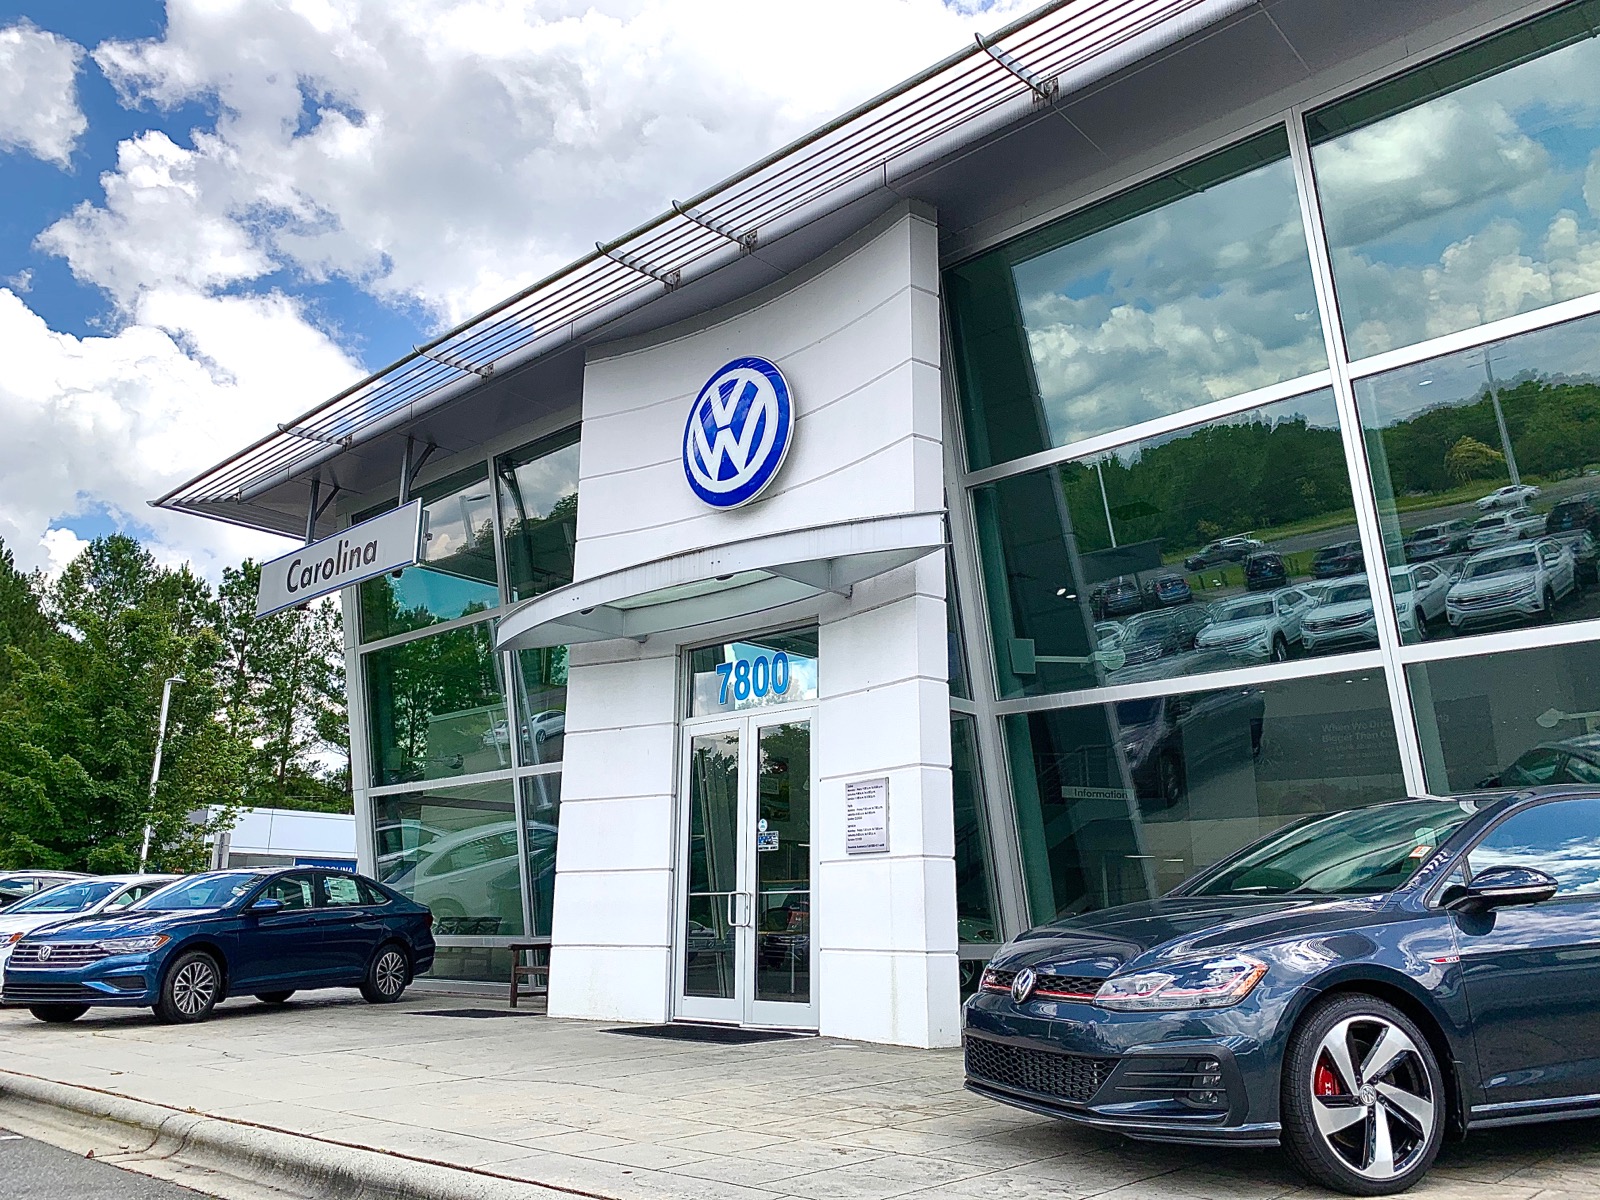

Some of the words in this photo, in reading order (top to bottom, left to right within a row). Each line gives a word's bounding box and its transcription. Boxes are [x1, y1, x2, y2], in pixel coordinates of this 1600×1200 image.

[286, 539, 378, 593] Carolina
[716, 651, 789, 705] 7800
[1074, 788, 1128, 799] Information
[316, 865, 353, 873] OLINA
